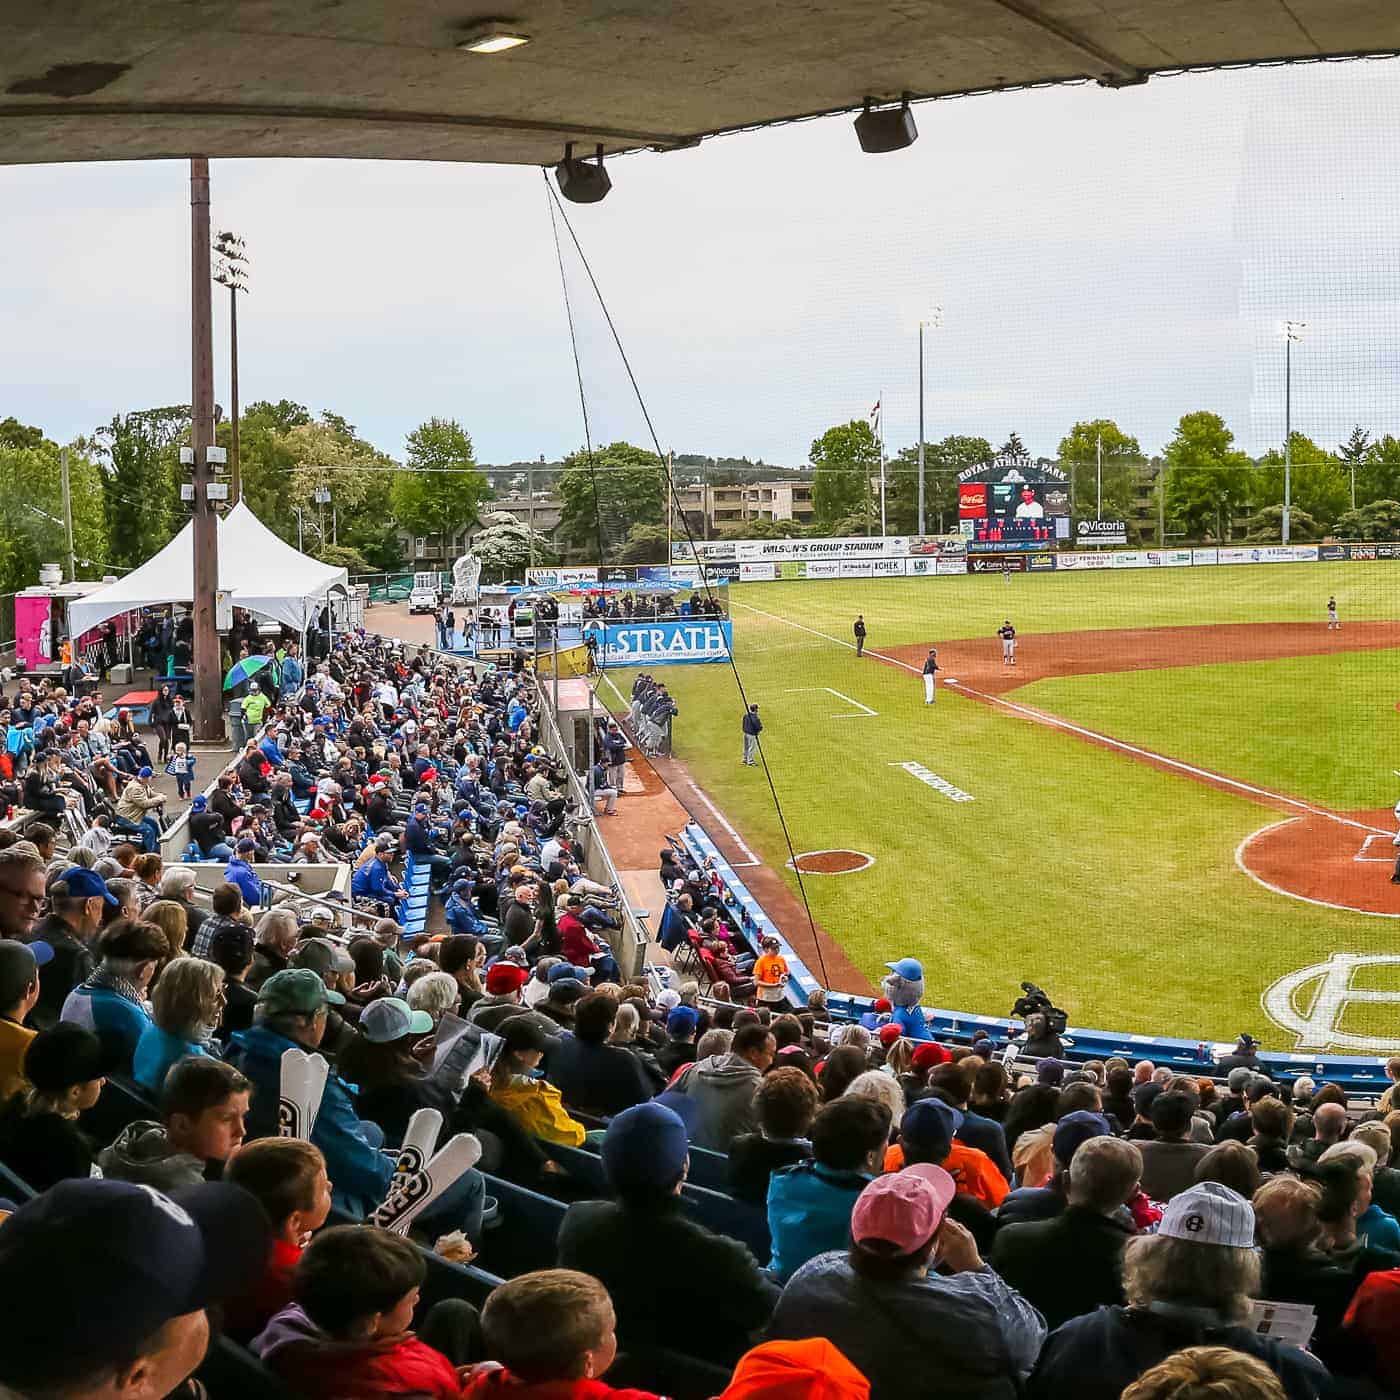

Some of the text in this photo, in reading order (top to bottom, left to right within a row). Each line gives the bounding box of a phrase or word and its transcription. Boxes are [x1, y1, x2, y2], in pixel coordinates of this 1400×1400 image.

[958, 456, 1068, 482] ROYAL ATHLETIC PARK
[1089, 520, 1125, 531] Victoria
[810, 543, 842, 552] GROUP
[844, 542, 884, 551] STADIUM
[617, 627, 727, 653] STRATH
